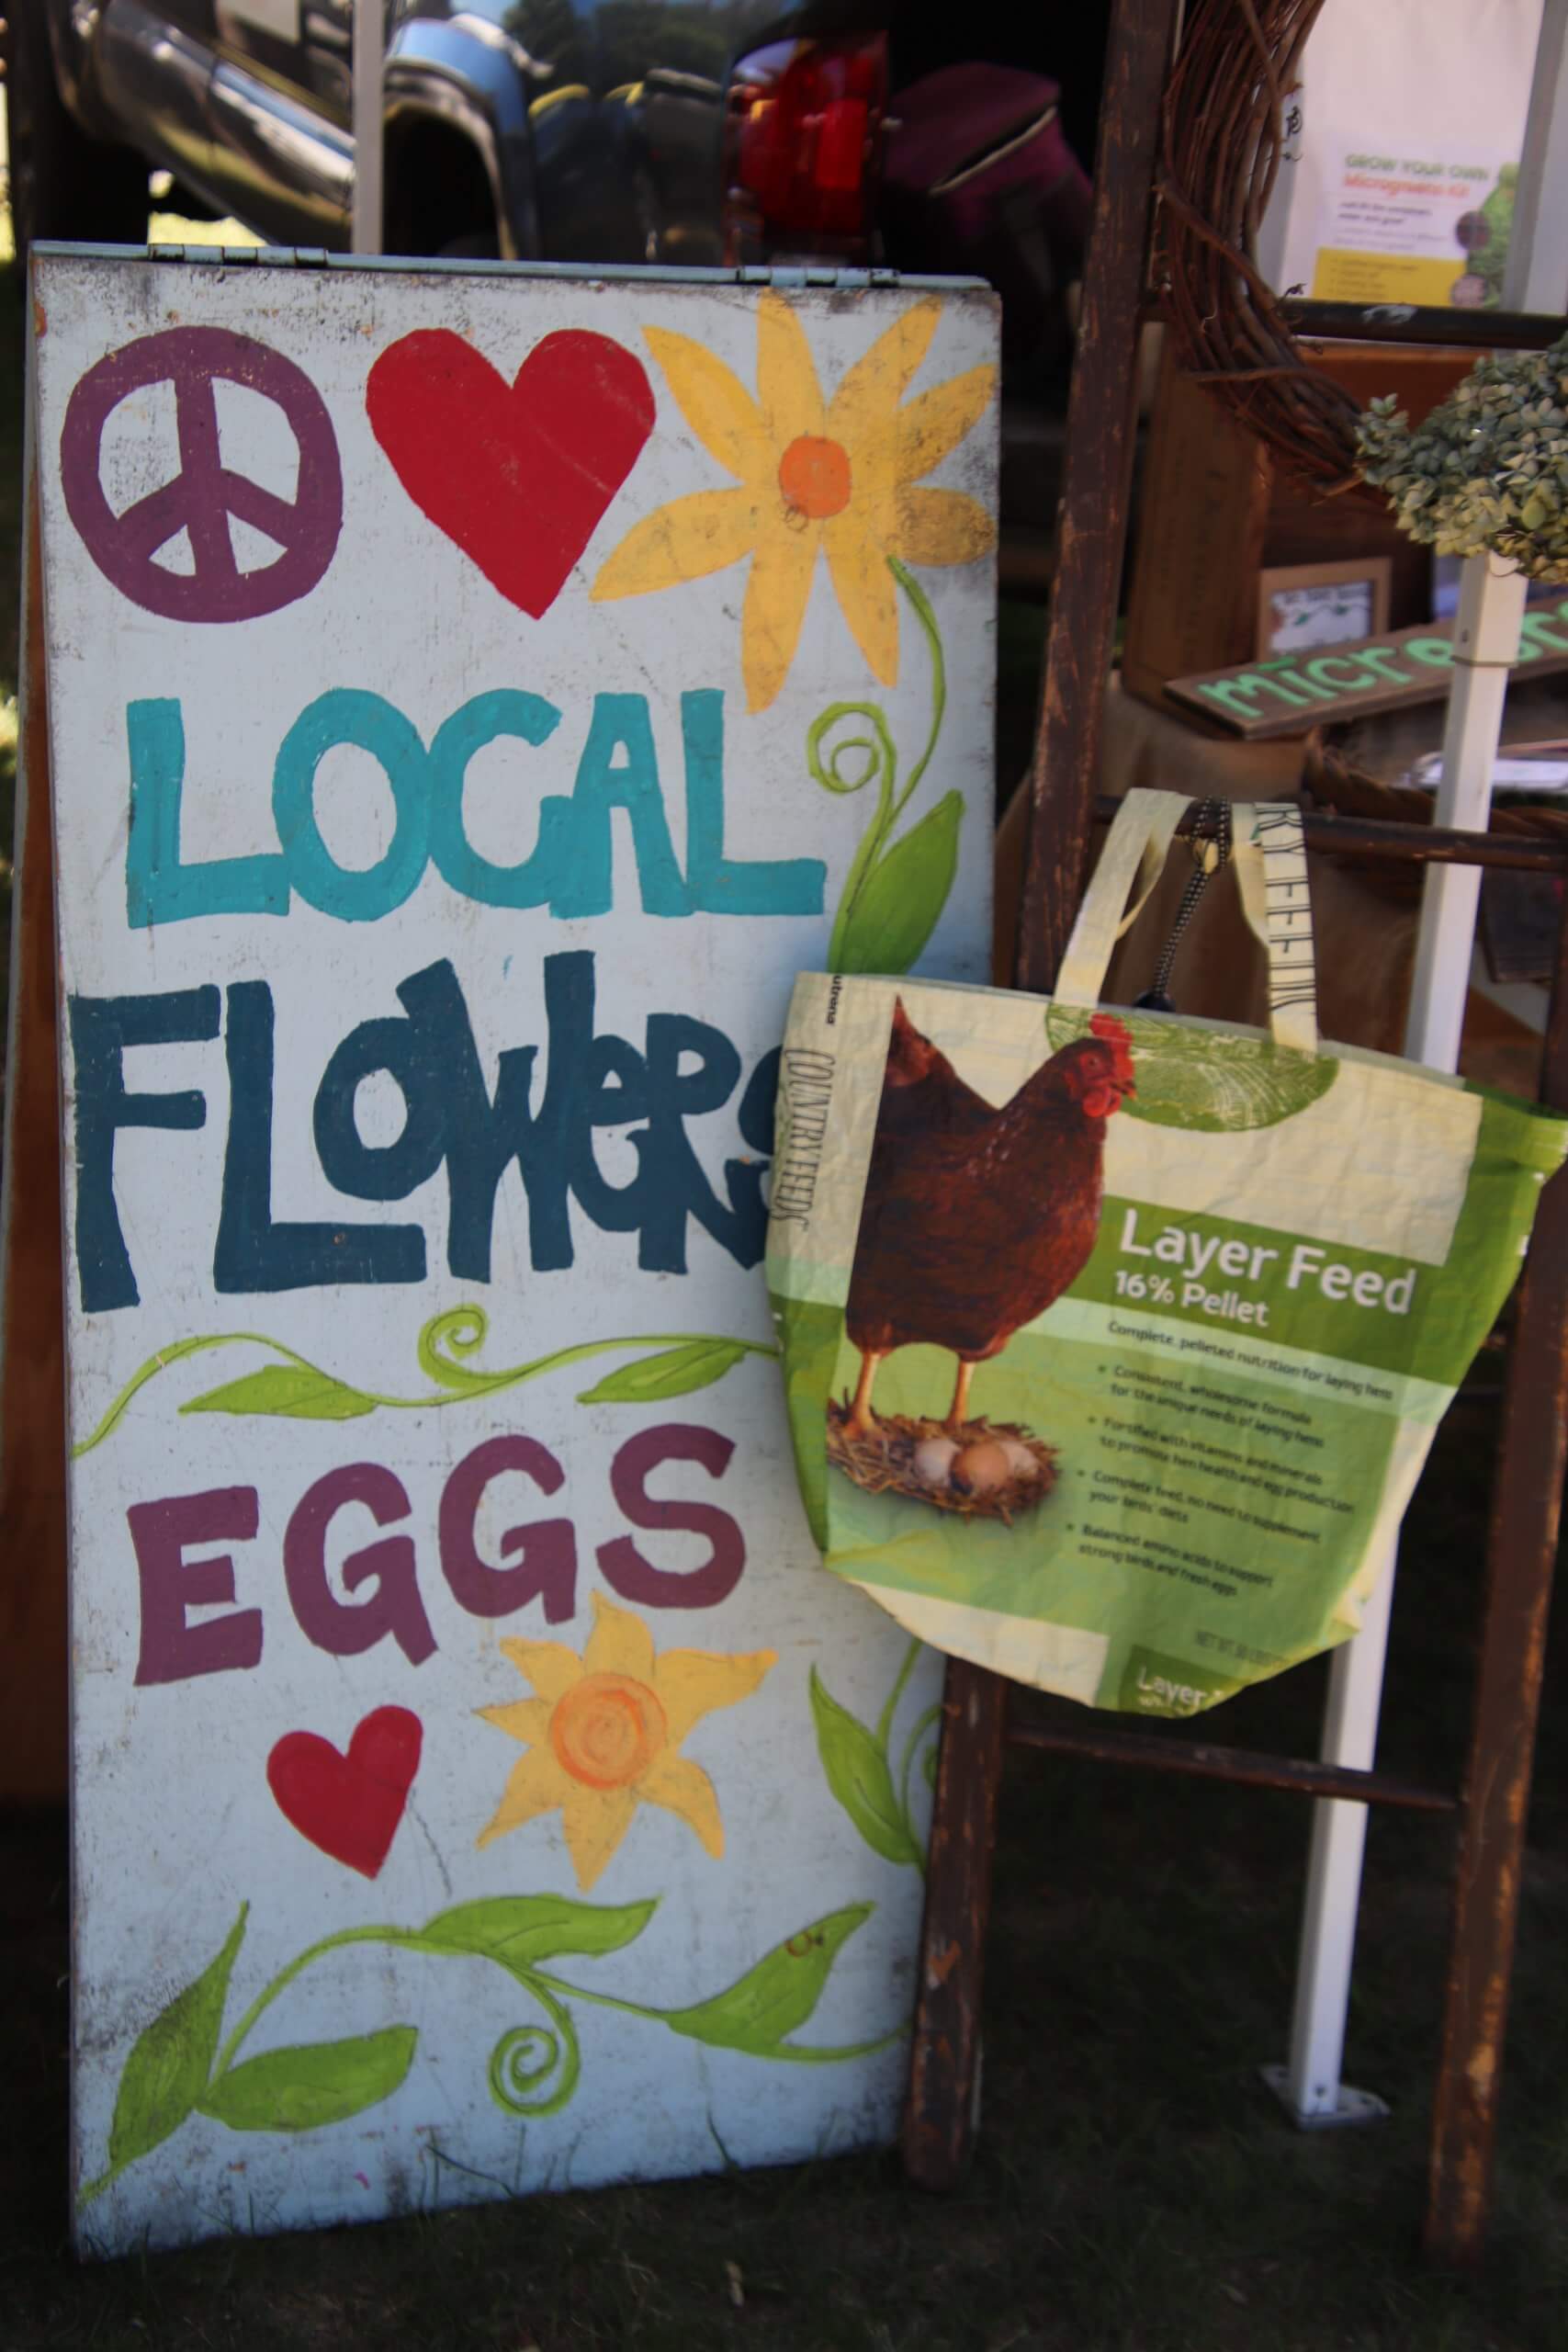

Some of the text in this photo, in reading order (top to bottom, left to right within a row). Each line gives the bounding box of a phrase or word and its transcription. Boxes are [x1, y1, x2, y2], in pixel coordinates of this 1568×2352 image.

[126, 686, 827, 929] LOCAL
[772, 1048, 835, 1229] COUNTRY FEEDS
[1114, 1270, 1269, 1327] 16% Pellet
[1120, 1208, 1417, 1315] Layer Feed
[1180, 1338, 1235, 1360] pelleted
[1237, 1351, 1302, 1374] nutrition
[1303, 1366, 1323, 1382] for
[1325, 1374, 1363, 1396] laying
[1365, 1380, 1393, 1400] hens
[126, 1422, 747, 1687] EGGS
[1135, 1664, 1209, 1710] Layer
